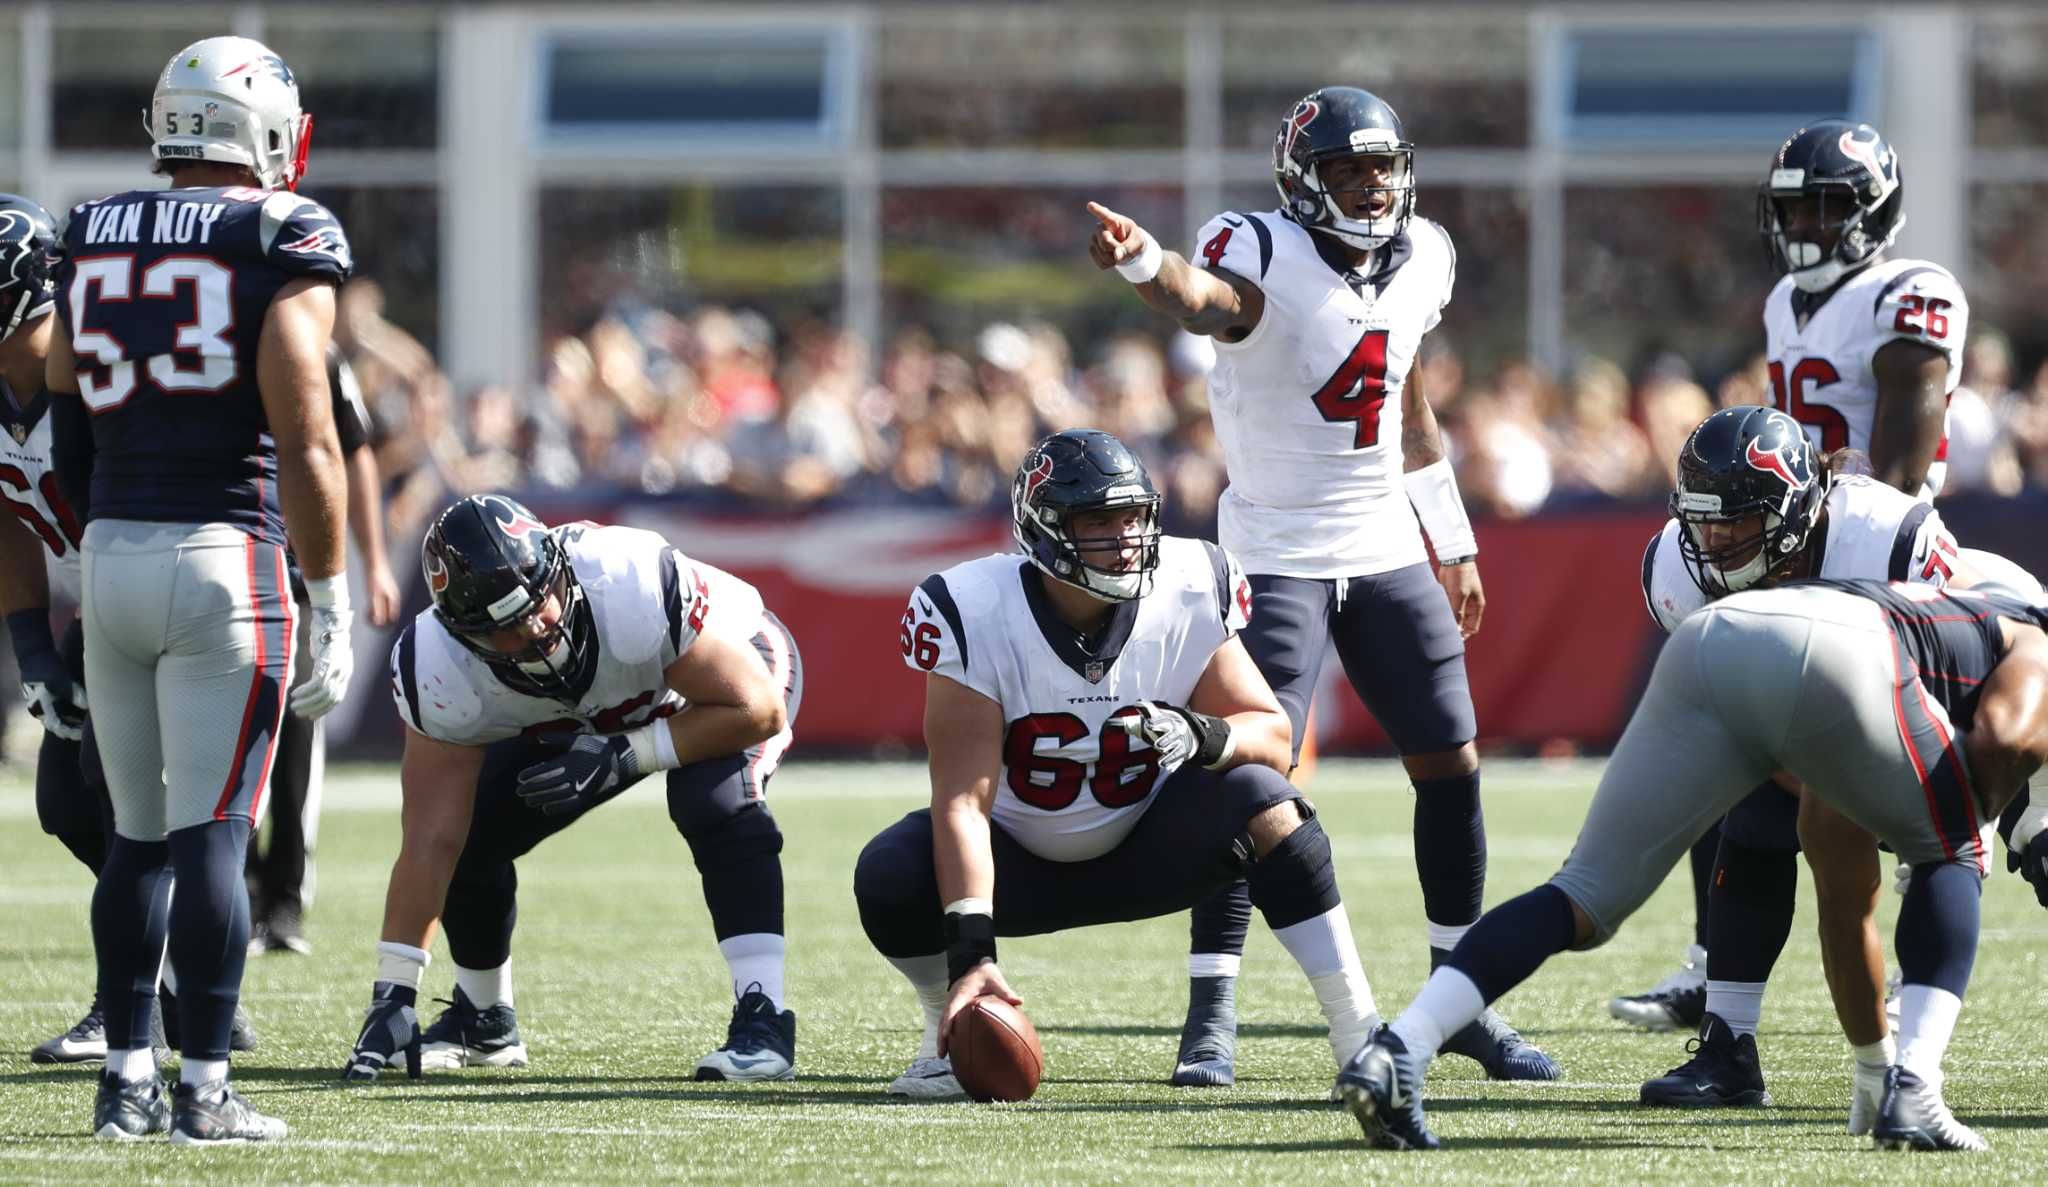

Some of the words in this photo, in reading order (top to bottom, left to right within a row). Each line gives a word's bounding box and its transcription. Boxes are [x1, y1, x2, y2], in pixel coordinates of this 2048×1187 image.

[159, 144, 204, 158] PATRIOTS
[85, 201, 144, 245] VAN
[152, 200, 225, 245] NOY
[1202, 227, 1234, 267] 4
[69, 253, 238, 416] 53
[1894, 294, 1952, 339] 26
[1311, 329, 1389, 449] 4
[1067, 695, 1120, 704] TEXANS
[1002, 700, 1173, 812] 66
